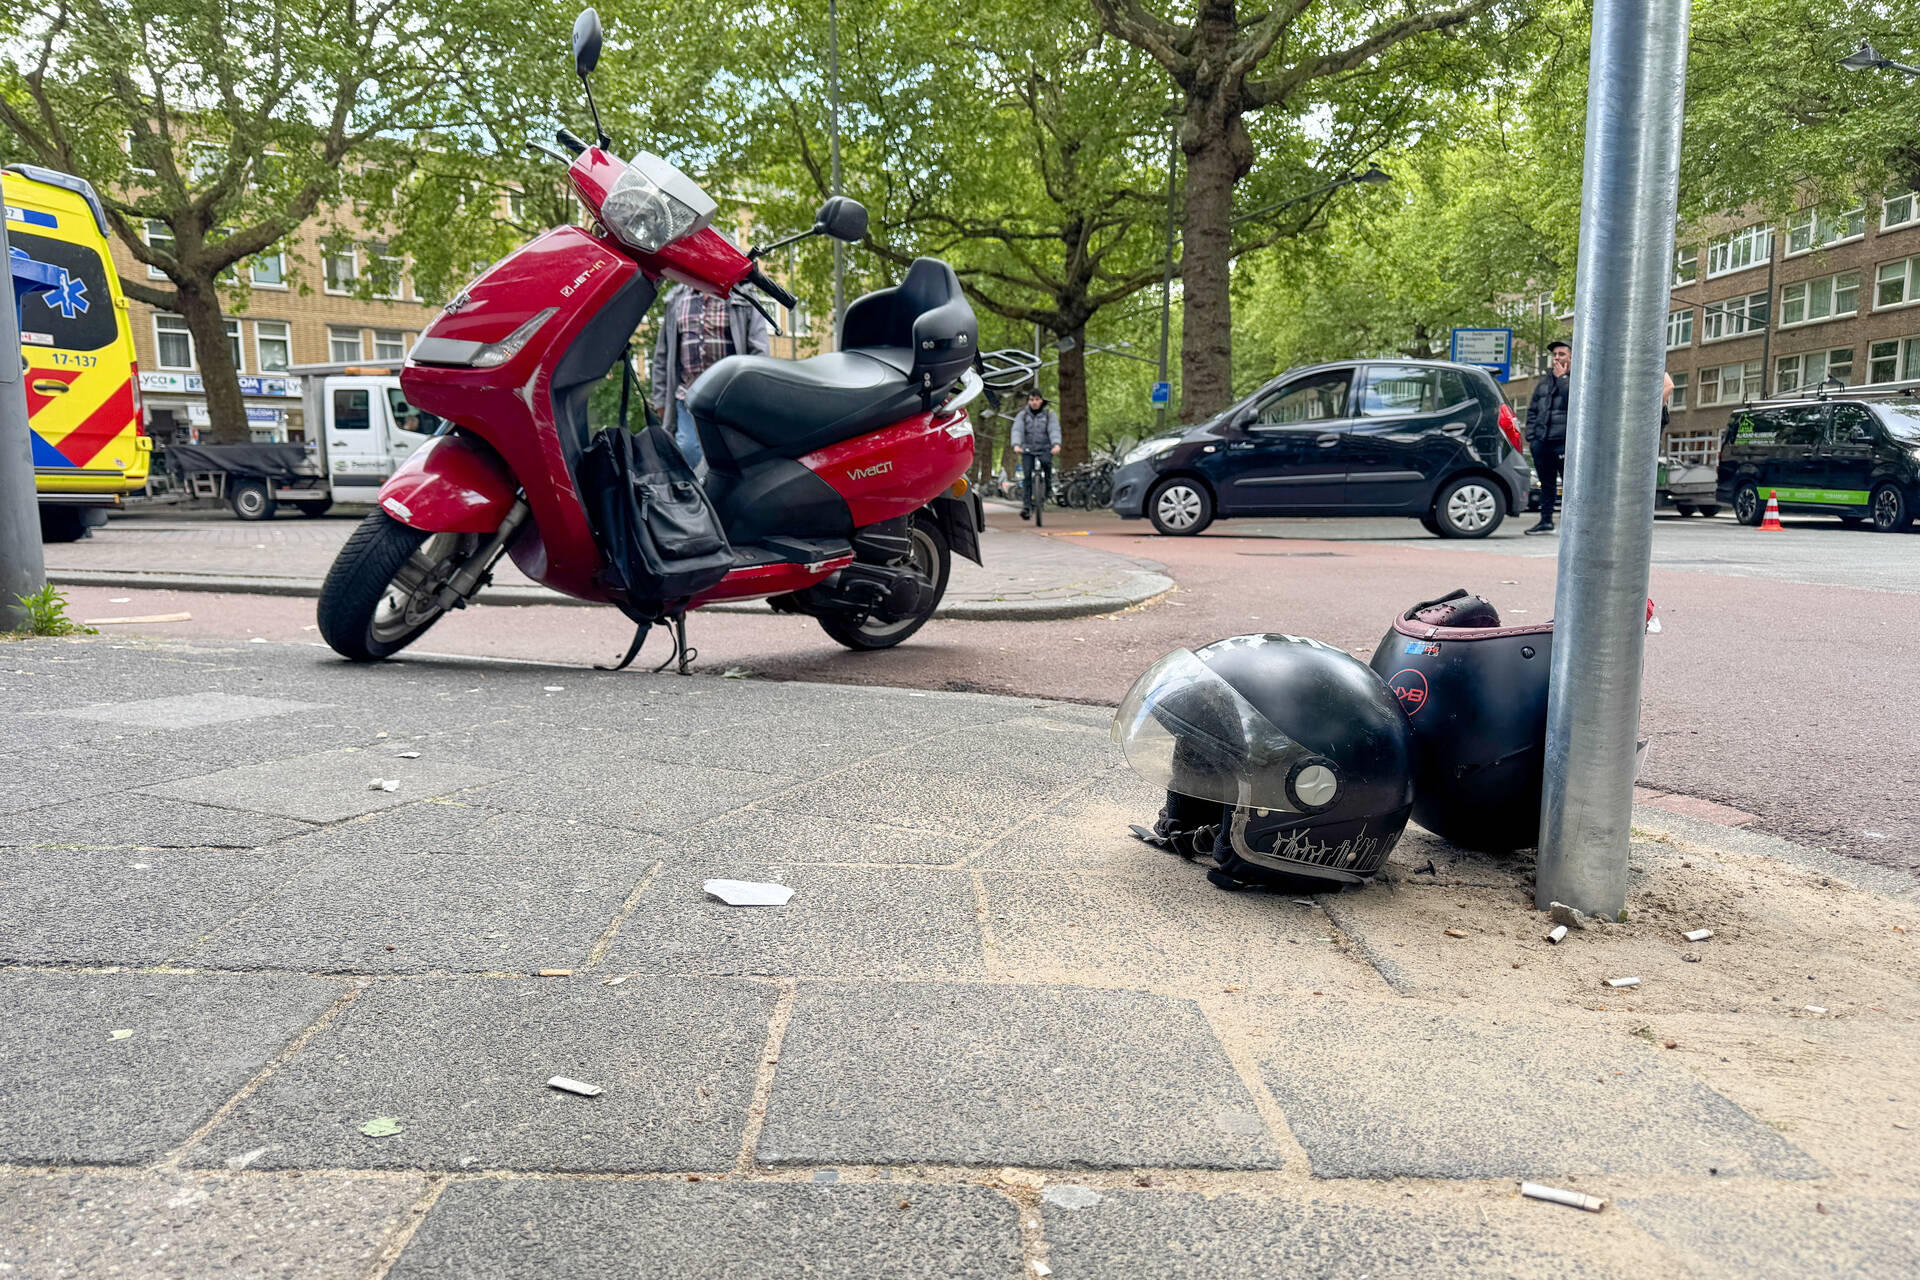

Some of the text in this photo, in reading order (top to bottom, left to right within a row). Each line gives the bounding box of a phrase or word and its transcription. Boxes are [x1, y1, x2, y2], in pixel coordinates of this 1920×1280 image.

[52, 353, 97, 368] 17-137
[140, 374, 167, 385] yca
[238, 378, 259, 388] OM
